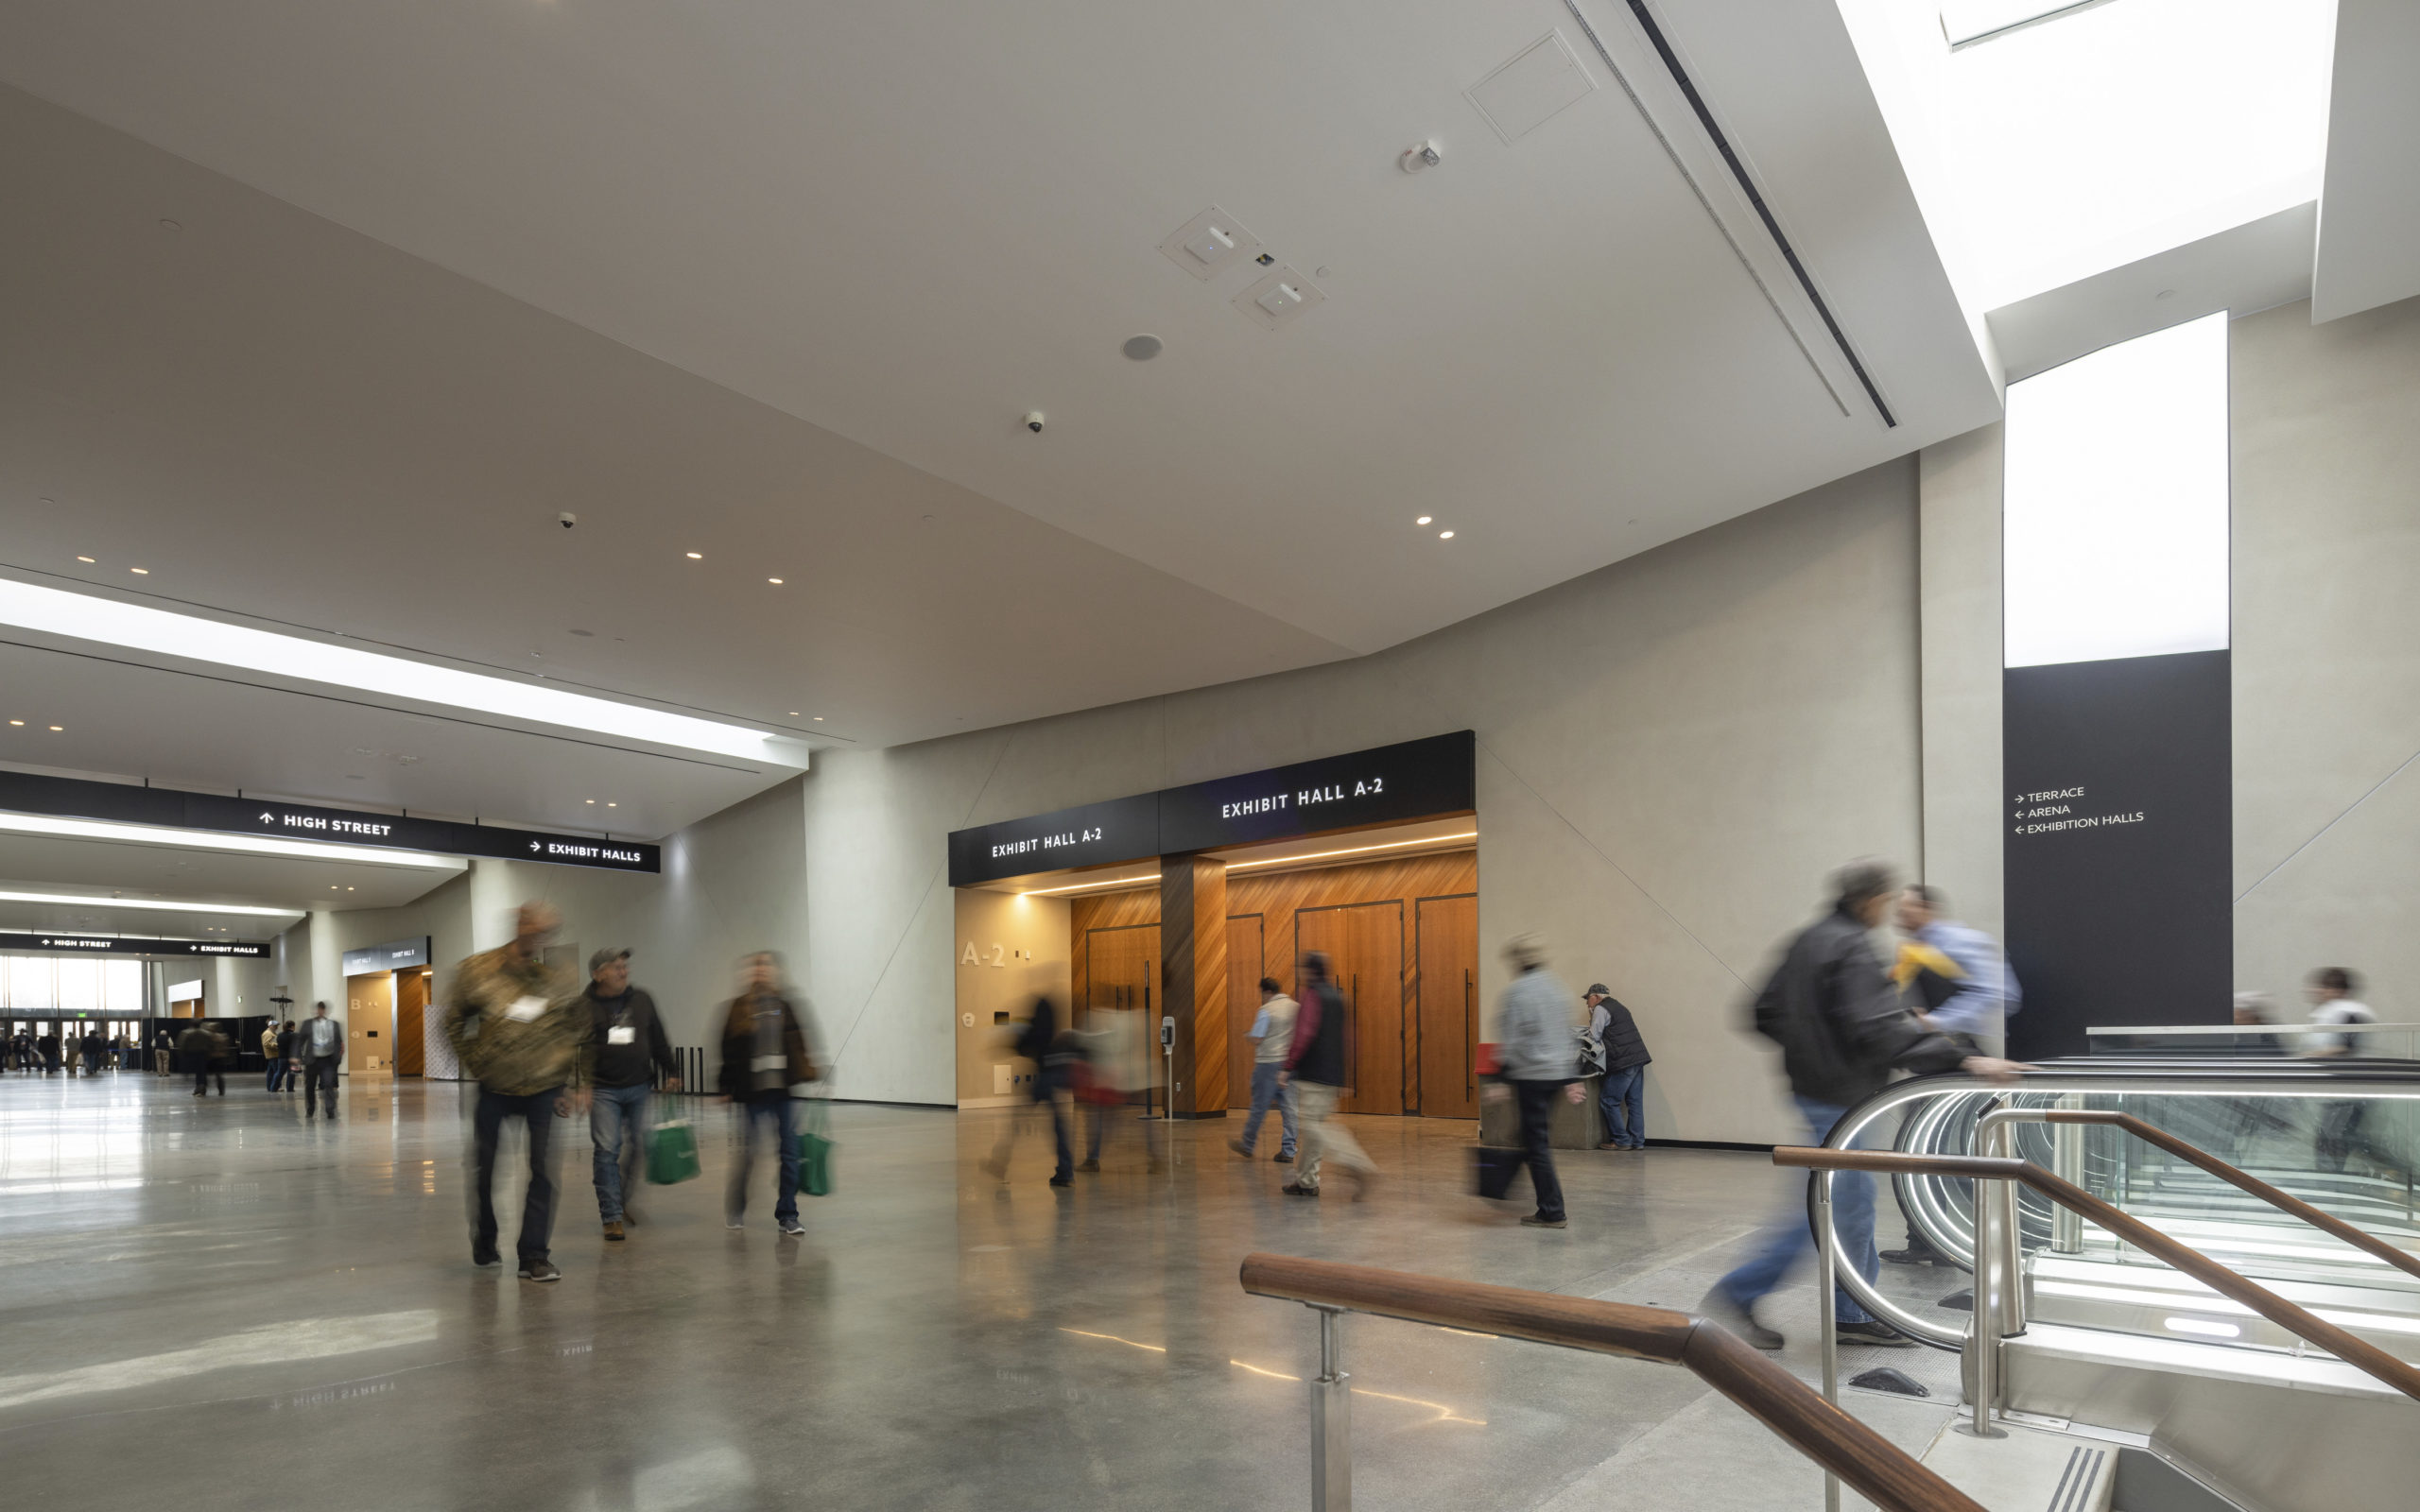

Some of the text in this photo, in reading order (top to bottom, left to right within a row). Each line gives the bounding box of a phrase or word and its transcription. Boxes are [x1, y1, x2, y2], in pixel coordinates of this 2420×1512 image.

[1222, 778, 1384, 819] EXHIBIT HALL A-2
[2027, 786, 2085, 803] TERRACE
[2028, 804, 2071, 818] ARENA
[284, 815, 391, 836] HIGH STREET
[2027, 811, 2145, 834] EXHIBITION HALLS
[548, 843, 642, 863] EXHIBIT HALLS
[992, 827, 1103, 858] EXHIBIT HALL A-2
[960, 941, 1005, 968] A-2
